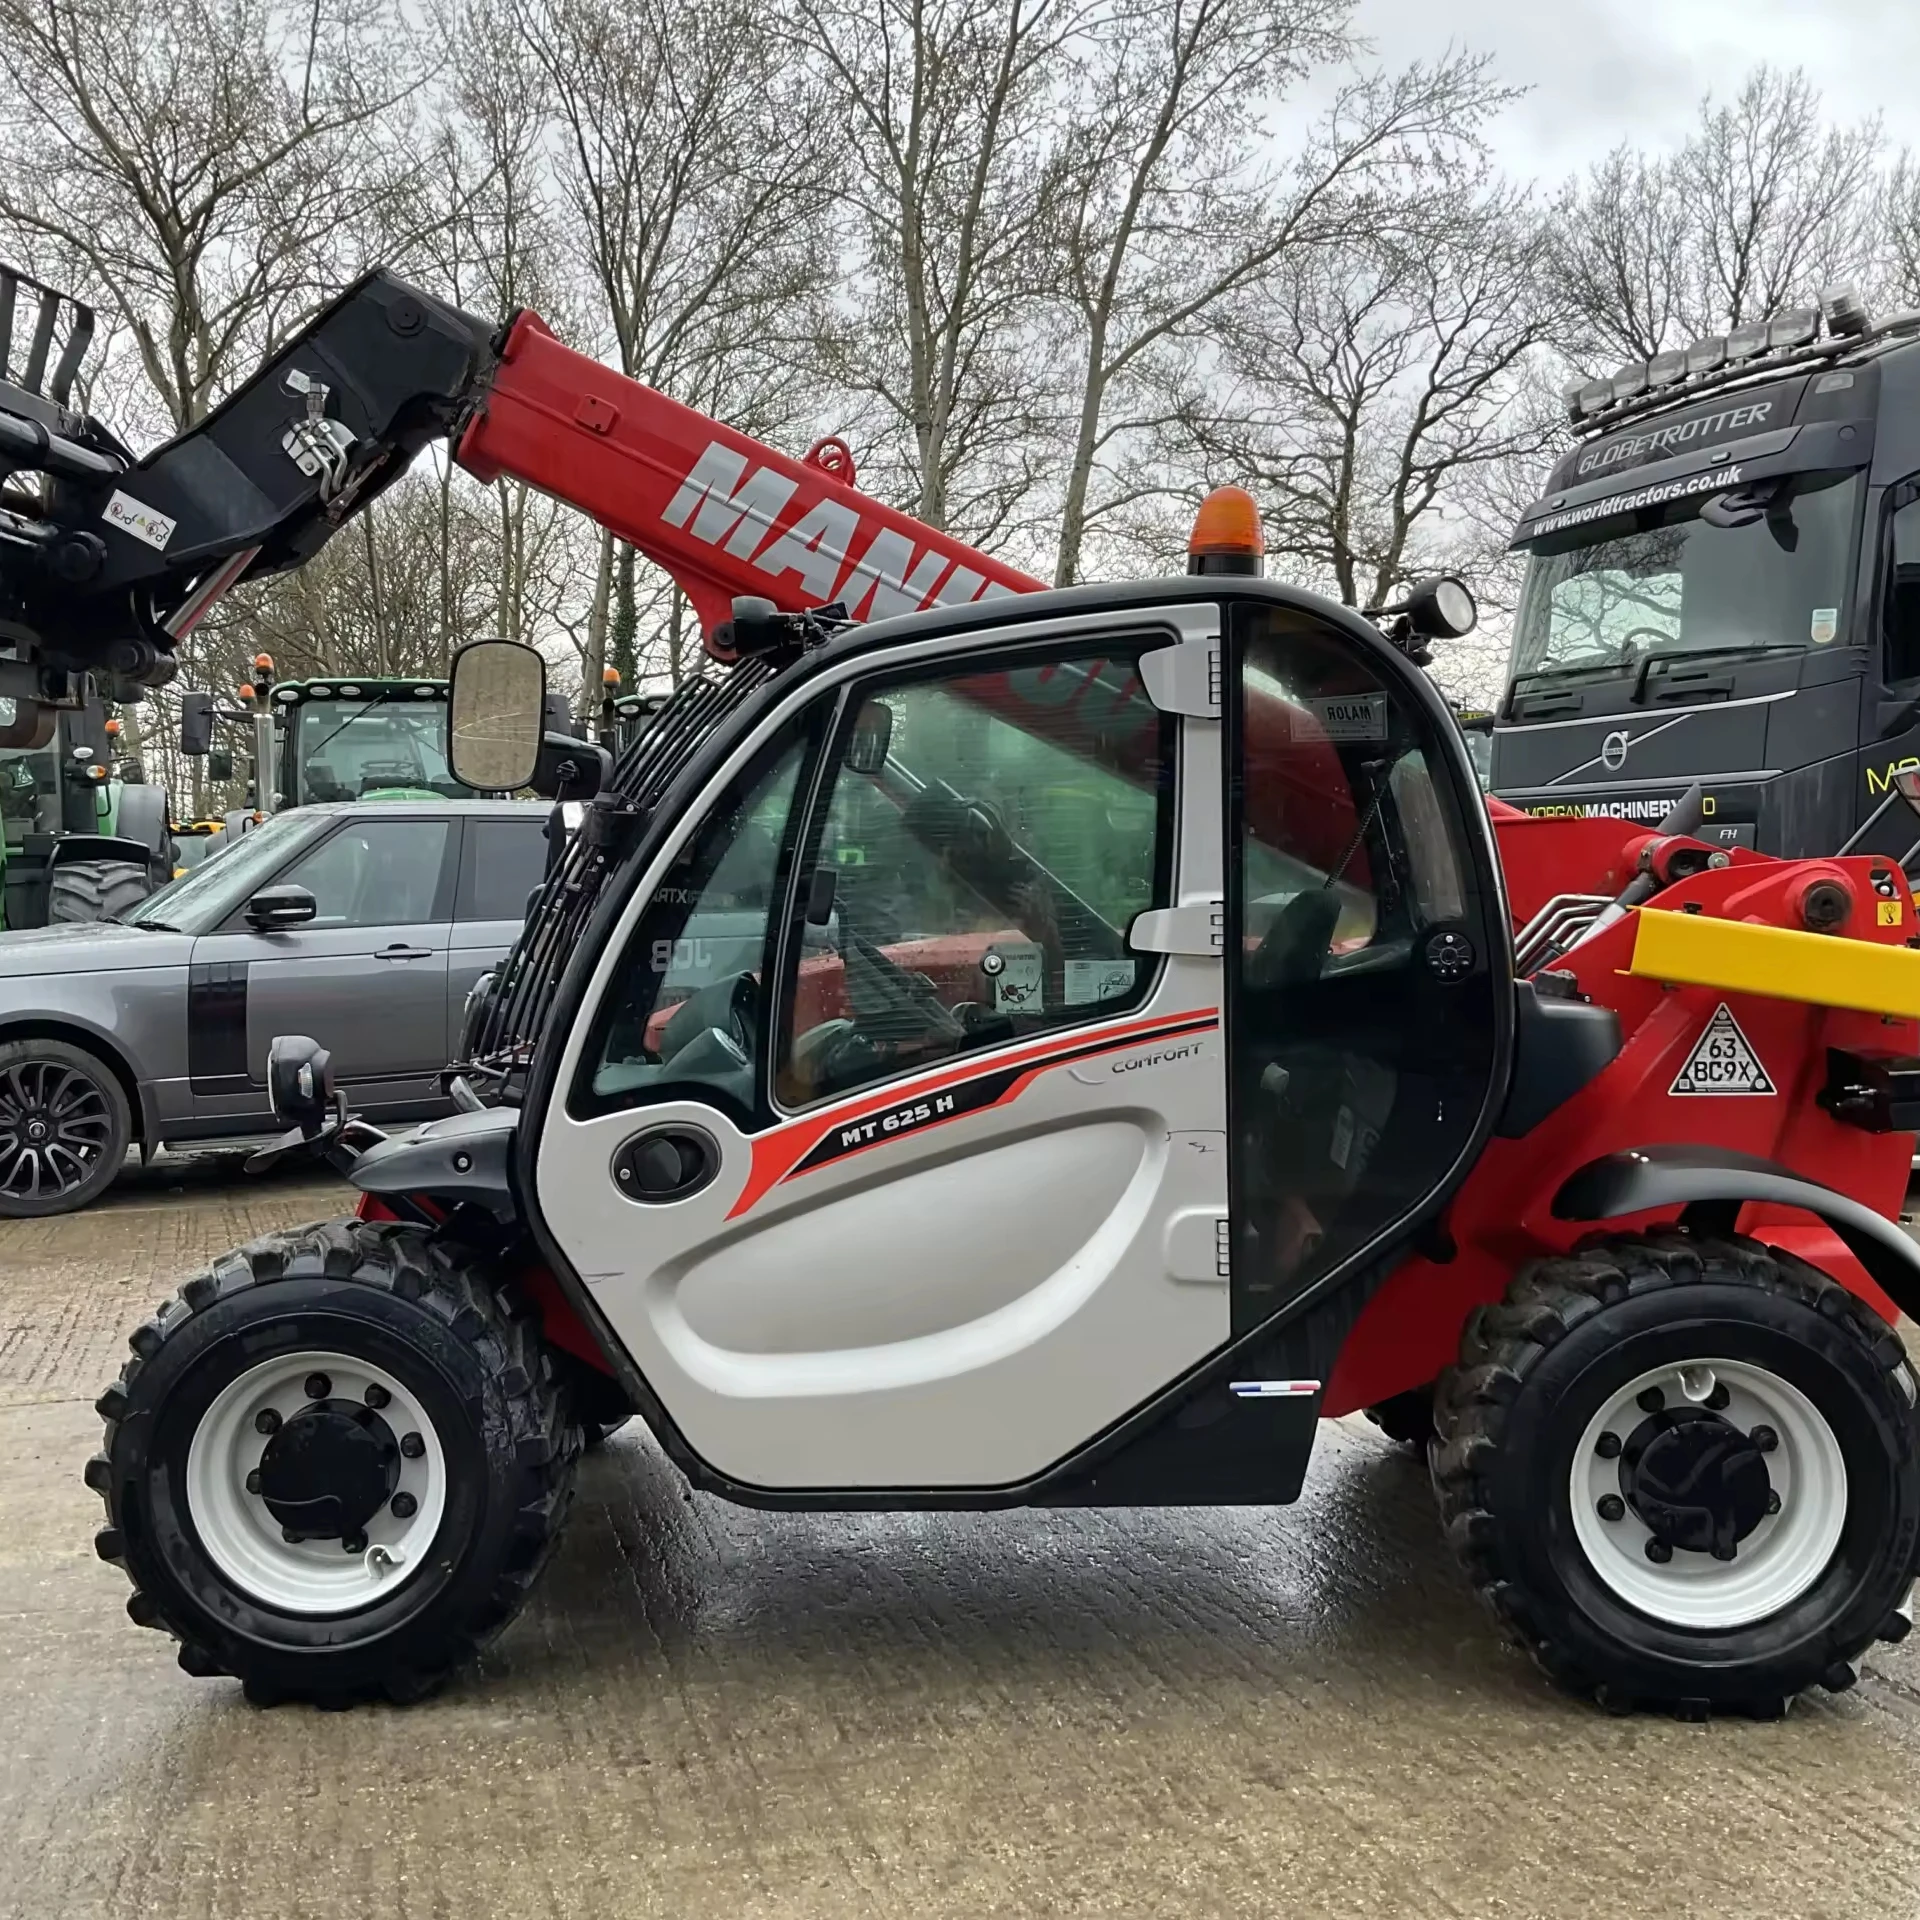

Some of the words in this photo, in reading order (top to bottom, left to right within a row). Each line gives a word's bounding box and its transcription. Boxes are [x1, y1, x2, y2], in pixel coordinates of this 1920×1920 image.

[1578, 401, 1773, 475] GLOBETROTTER
[1532, 464, 1743, 536] www.worldtractors.co.uk
[1719, 829, 1738, 840] FH
[1111, 1042, 1203, 1074] COMFORT
[1708, 1037, 1737, 1059] 63
[1693, 1060, 1751, 1083] BC9X
[841, 1123, 877, 1147] MT
[882, 1103, 931, 1132] 625
[936, 1094, 954, 1114] H
